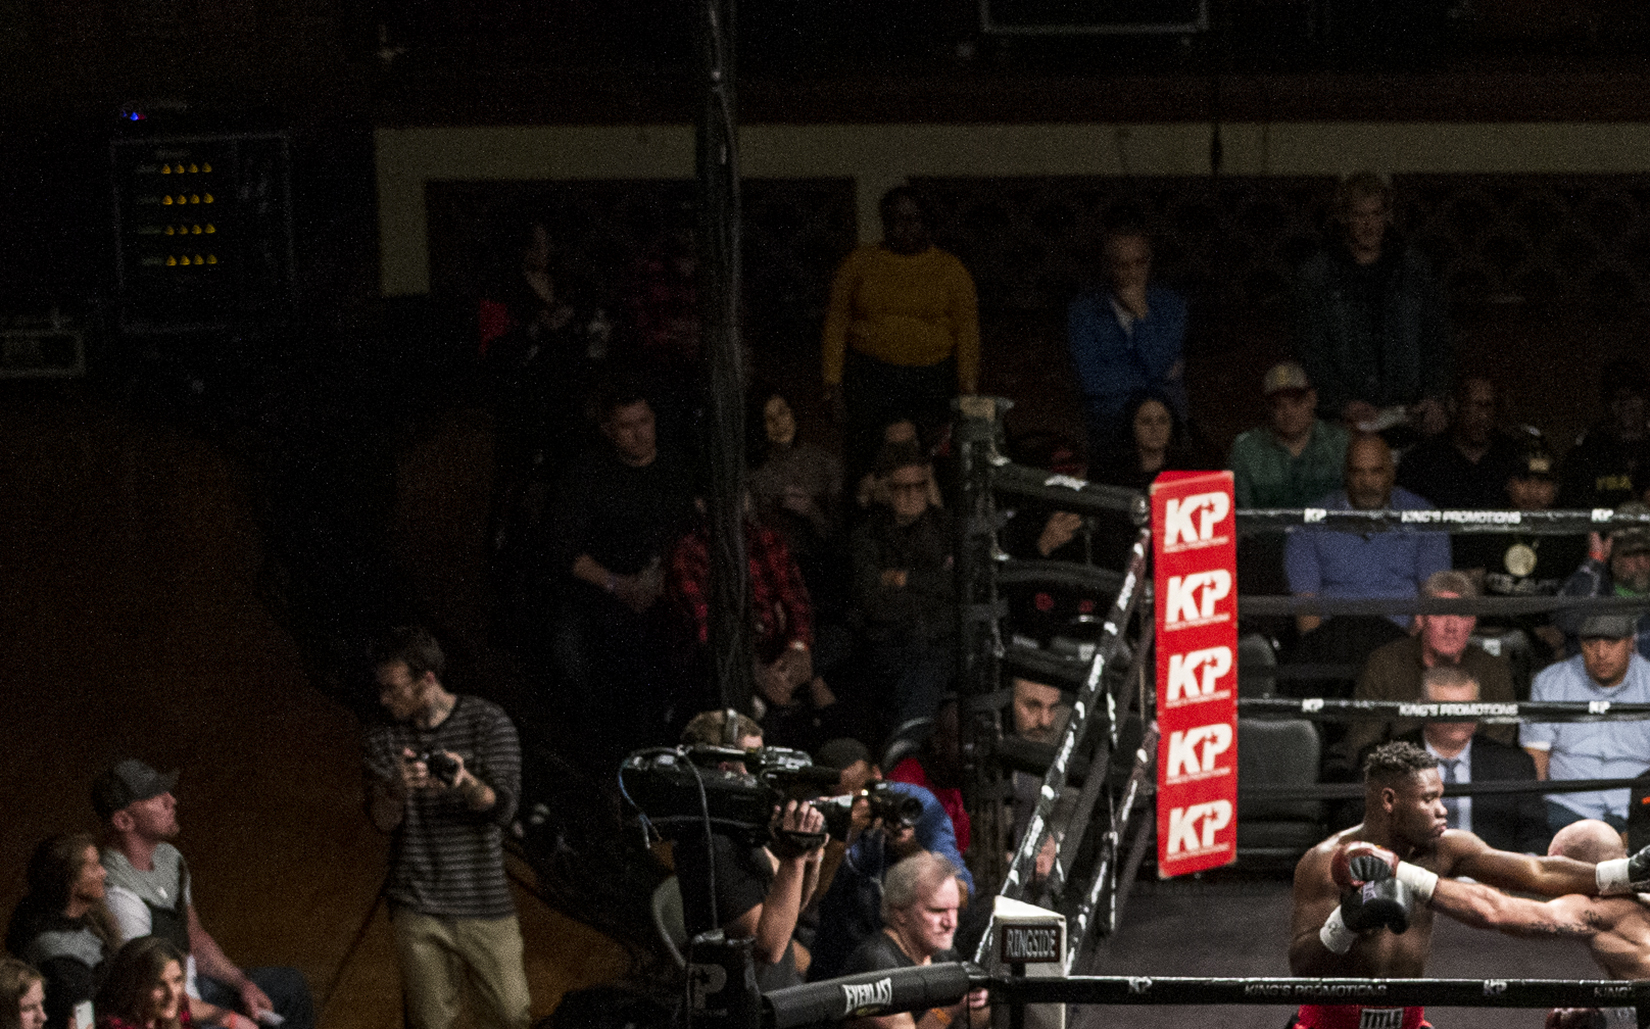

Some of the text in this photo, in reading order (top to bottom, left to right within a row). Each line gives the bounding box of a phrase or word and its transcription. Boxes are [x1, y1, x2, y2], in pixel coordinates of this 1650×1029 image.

[1164, 491, 1231, 548] KP
[1165, 568, 1233, 624] KP
[1167, 645, 1234, 701] KP
[1167, 722, 1234, 779] KP
[1167, 799, 1234, 856] KP
[1005, 928, 1058, 959] RINGSIDE
[842, 977, 893, 1016] EVERLAST
[1294, 983, 1389, 997] PROMOTIONS
[1363, 1010, 1402, 1029] TITLE
